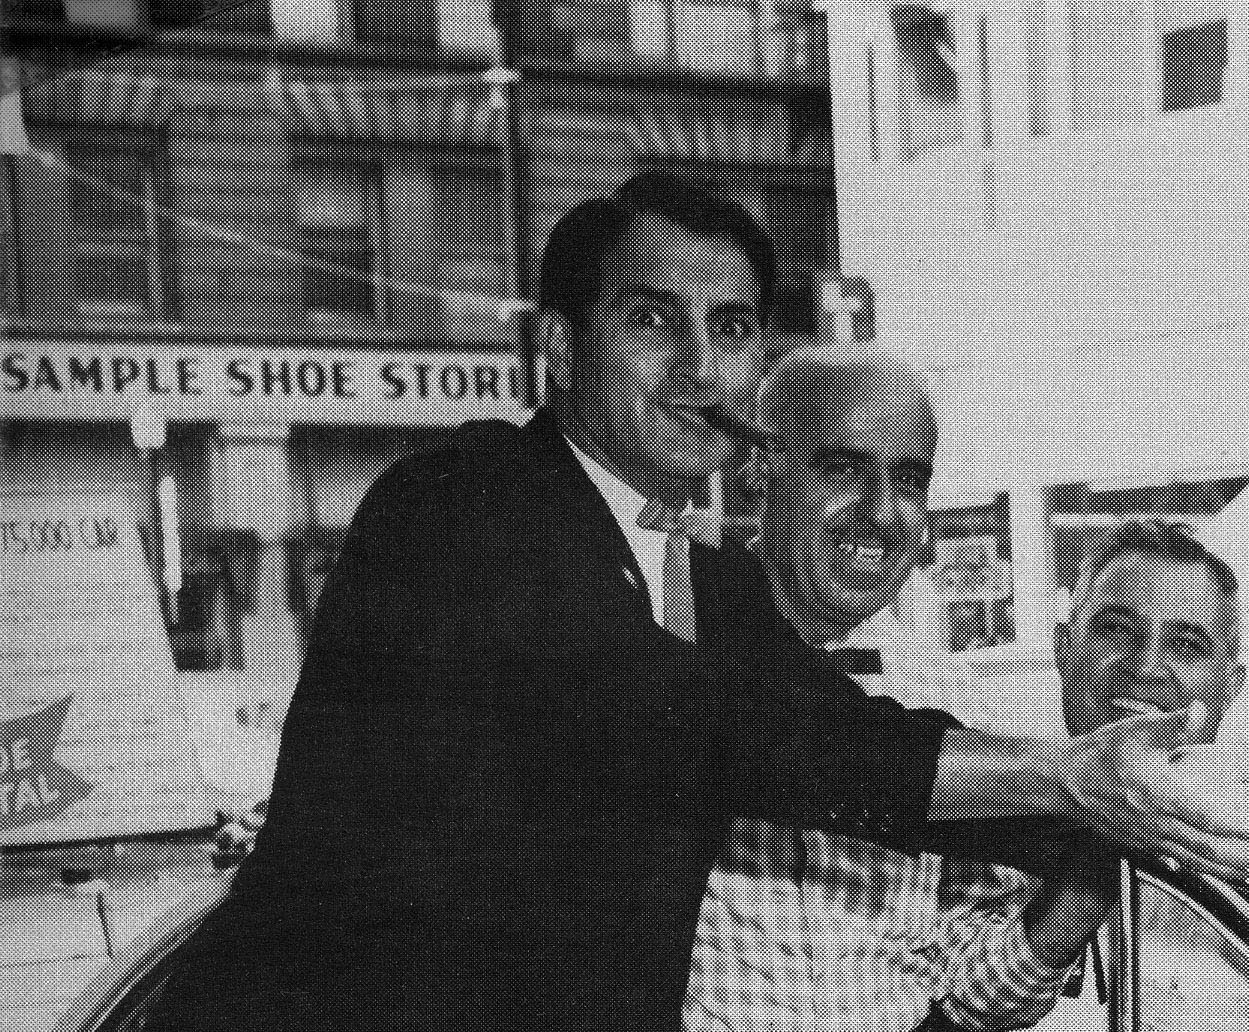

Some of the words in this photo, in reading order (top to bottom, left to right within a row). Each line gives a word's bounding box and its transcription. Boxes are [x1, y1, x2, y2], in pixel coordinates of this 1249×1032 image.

[1, 357, 202, 394] SAMPLE
[226, 360, 357, 398] SHOE
[379, 364, 521, 399] STOR
